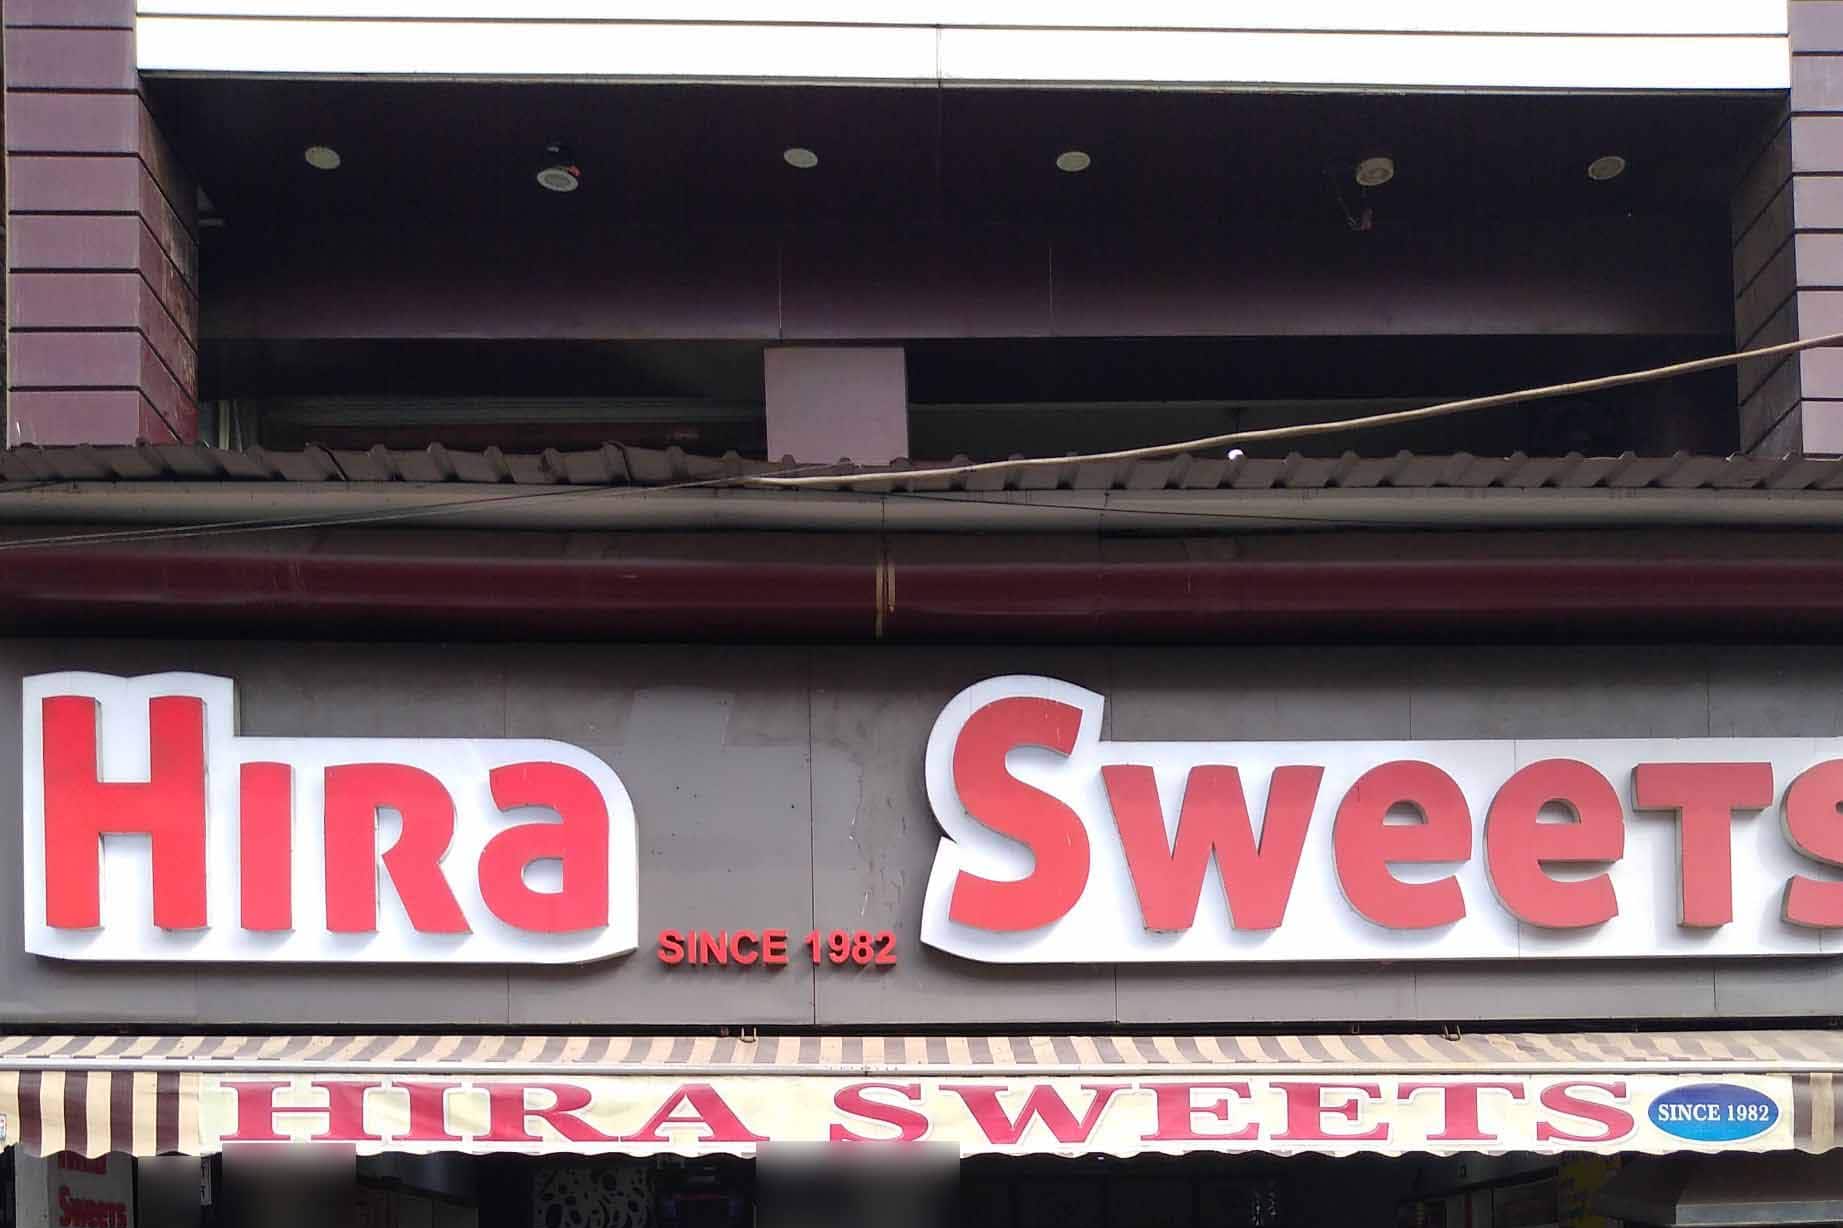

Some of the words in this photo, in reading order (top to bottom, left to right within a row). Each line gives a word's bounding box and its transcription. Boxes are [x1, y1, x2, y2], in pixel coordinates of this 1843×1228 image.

[656, 928, 790, 966] SINCE
[804, 928, 898, 966] 1982
[219, 1080, 770, 1142] HIRA
[829, 1080, 1636, 1145] SWEETS
[1658, 1103, 1721, 1121] SINCE
[1727, 1103, 1769, 1121] 1982
